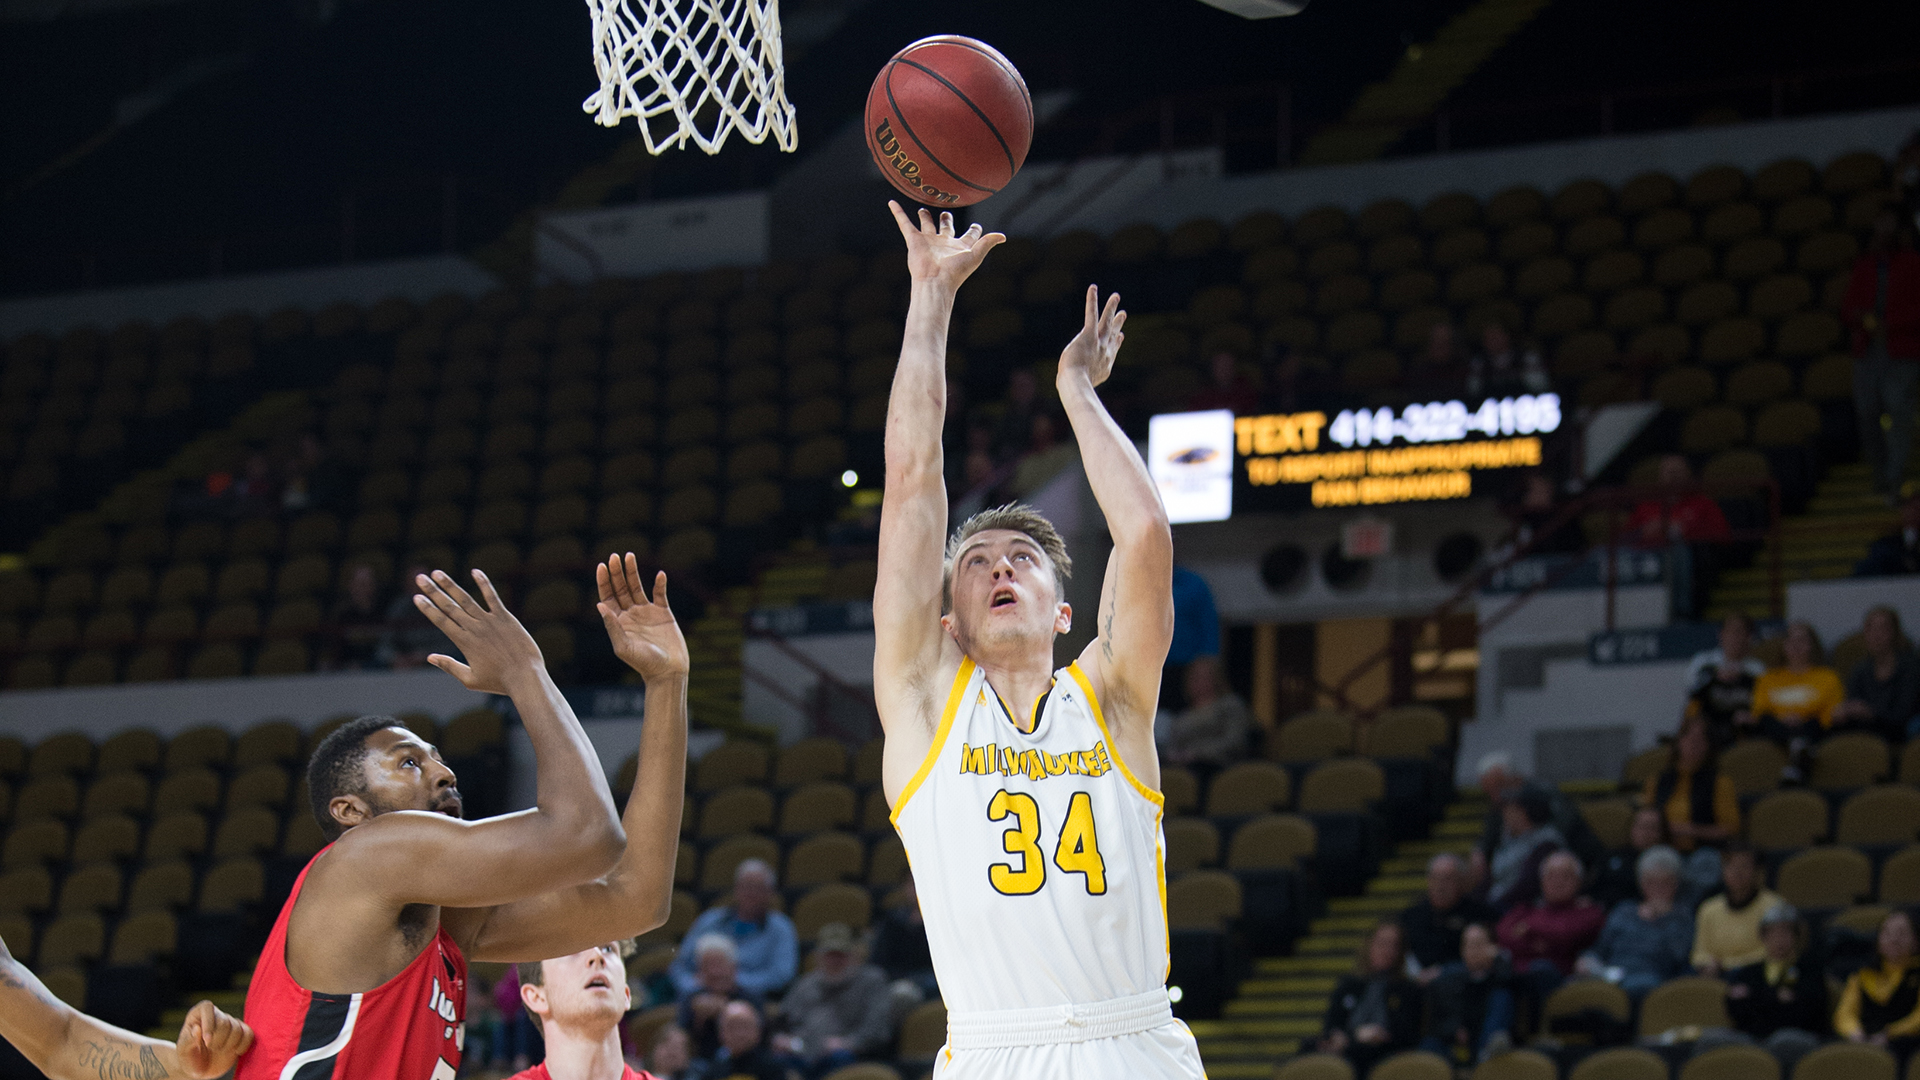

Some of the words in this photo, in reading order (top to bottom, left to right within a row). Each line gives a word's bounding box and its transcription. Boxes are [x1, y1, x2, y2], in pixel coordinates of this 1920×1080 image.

[875, 117, 960, 203] Wilson
[1235, 411, 1327, 456] TEXT
[1280, 450, 1366, 483] REPORT
[1368, 437, 1541, 474] INAPPROPRIATE
[1311, 479, 1358, 507] FAN
[1360, 471, 1472, 504] BEHAVIOR
[959, 740, 1113, 781] MILWAUKEE
[987, 788, 1107, 896] 34
